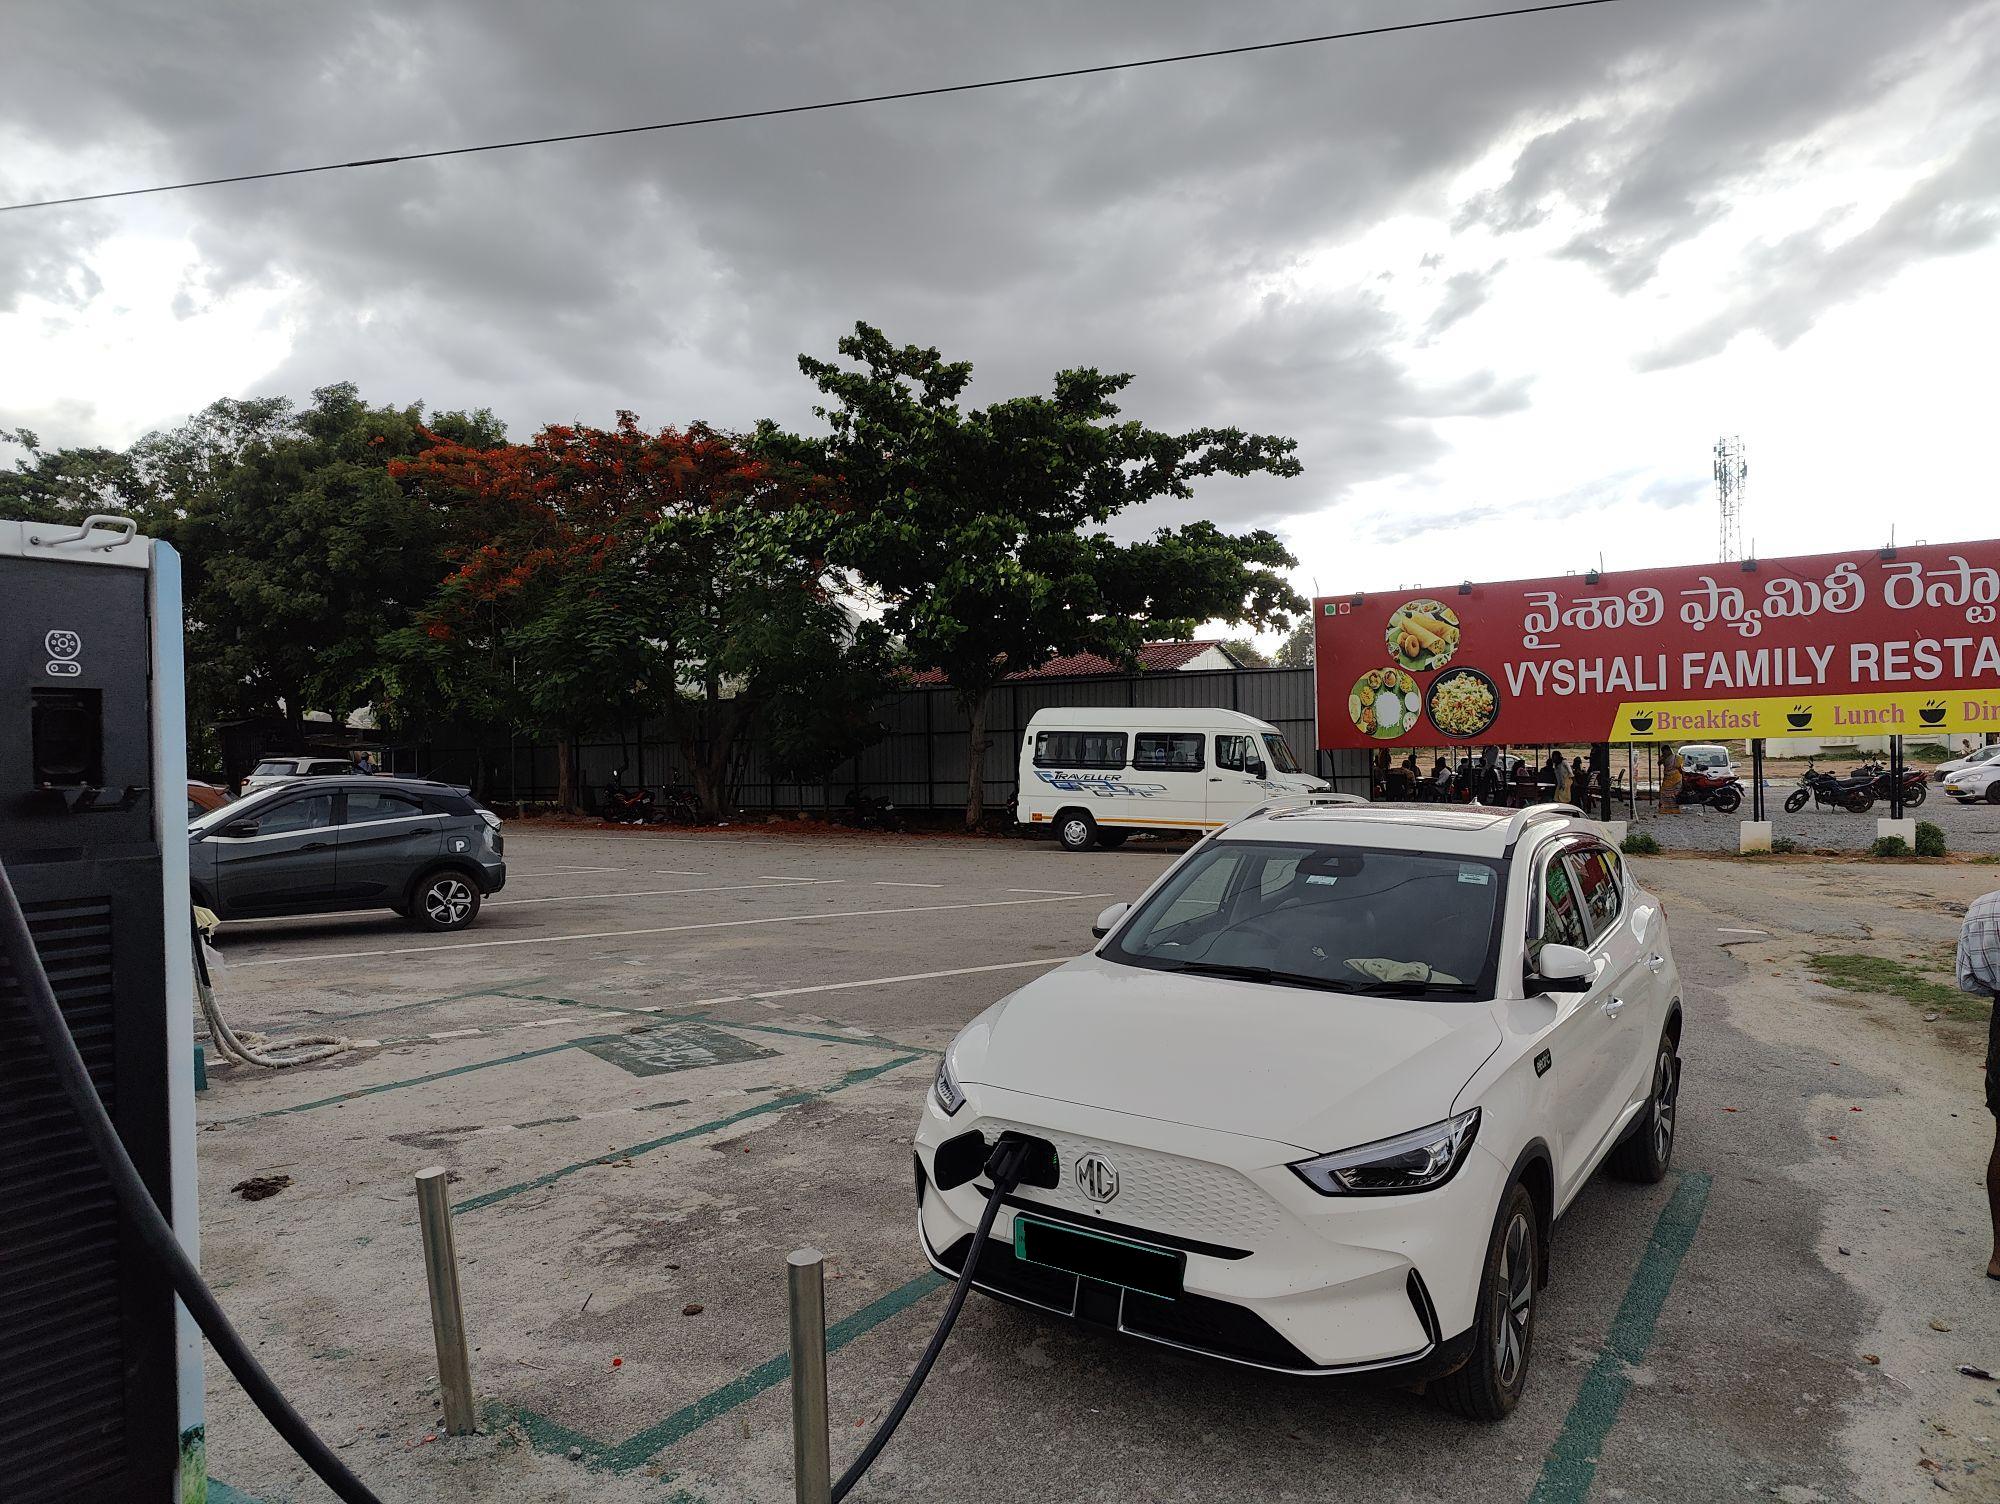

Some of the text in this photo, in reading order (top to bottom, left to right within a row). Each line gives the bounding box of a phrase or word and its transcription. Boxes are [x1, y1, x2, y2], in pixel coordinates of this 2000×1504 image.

[1522, 587, 1665, 650] వైశాలి
[1680, 561, 1866, 638] ఫ్యామిలీ
[1503, 636, 2000, 697] VYSHALI FAMILY RESTA
[1656, 709, 1761, 731] Breakfast
[1833, 702, 1905, 725] Lunch
[1078, 1156, 1115, 1200] MG
